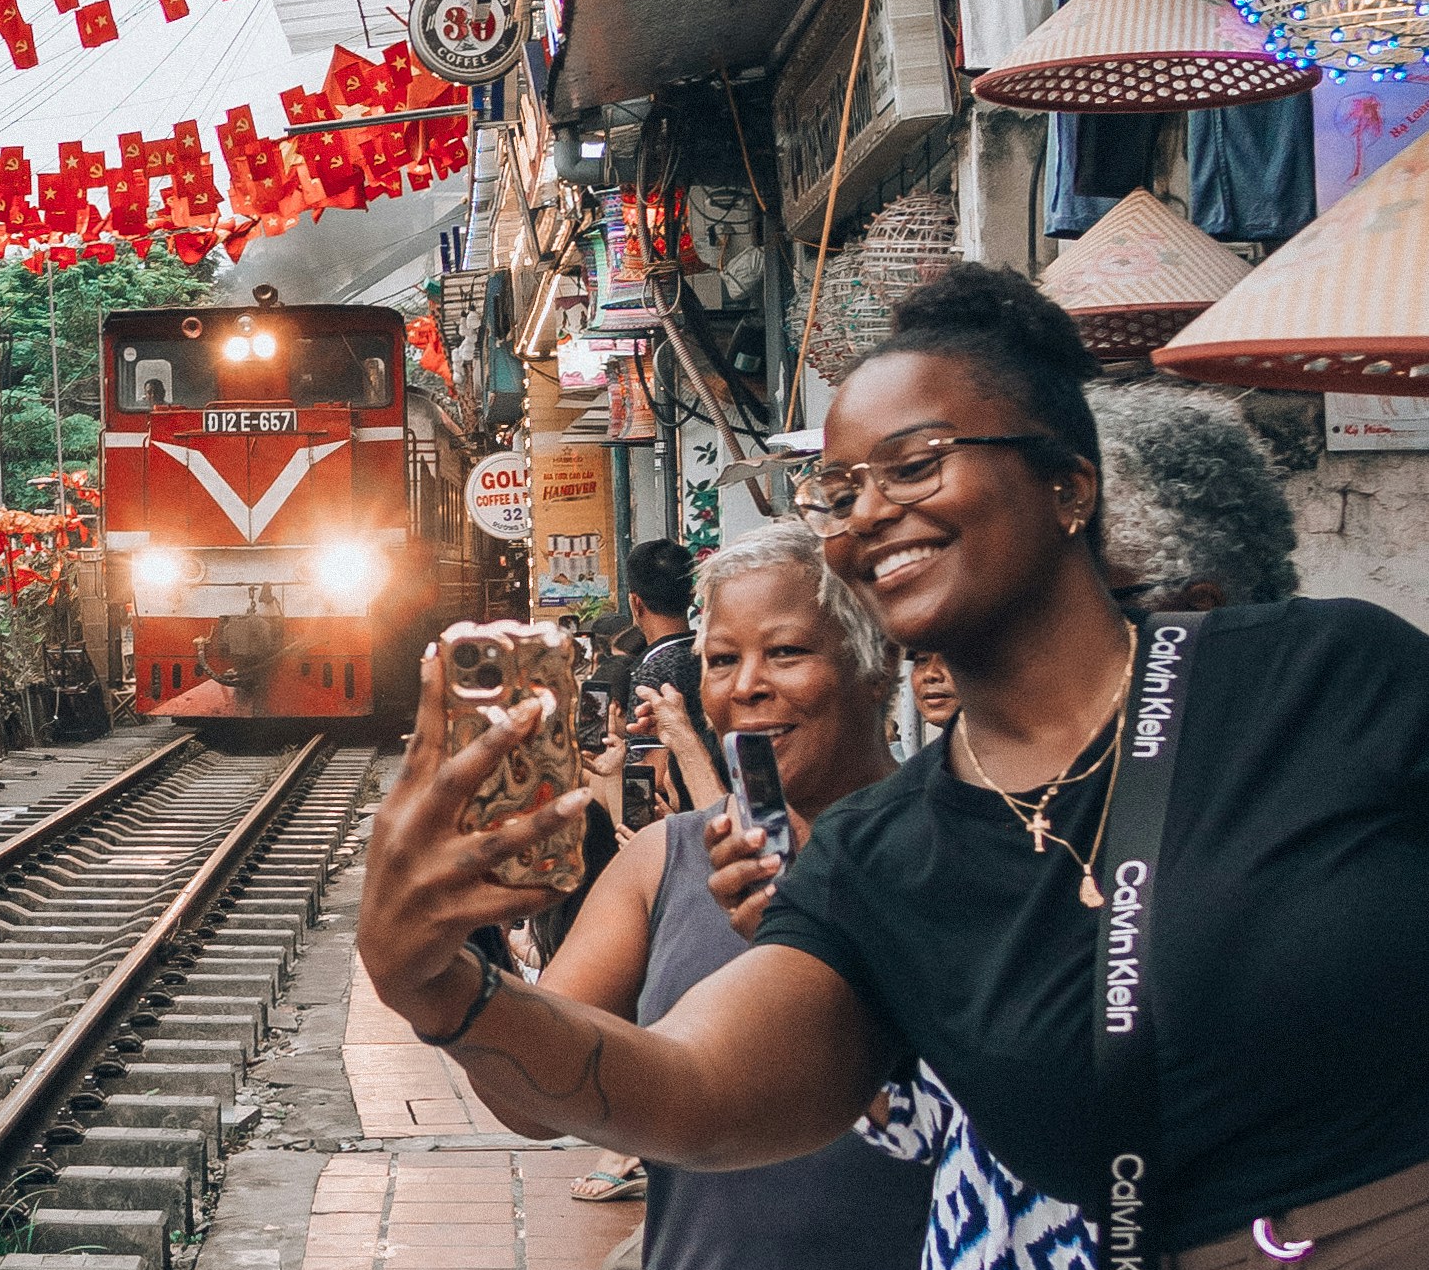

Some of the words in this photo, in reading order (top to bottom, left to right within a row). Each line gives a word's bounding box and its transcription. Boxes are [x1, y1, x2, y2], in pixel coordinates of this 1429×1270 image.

[437, 46, 489, 67] COFFEE
[476, 494, 510, 506] COFFEE
[513, 492, 520, 505] &
[503, 507, 523, 521] 32
[1142, 626, 1187, 693] Calvin
[1132, 698, 1174, 758] Klein
[1108, 860, 1148, 954] Calvin
[1106, 958, 1139, 1032] Klein
[1110, 1153, 1145, 1250] Calvin
